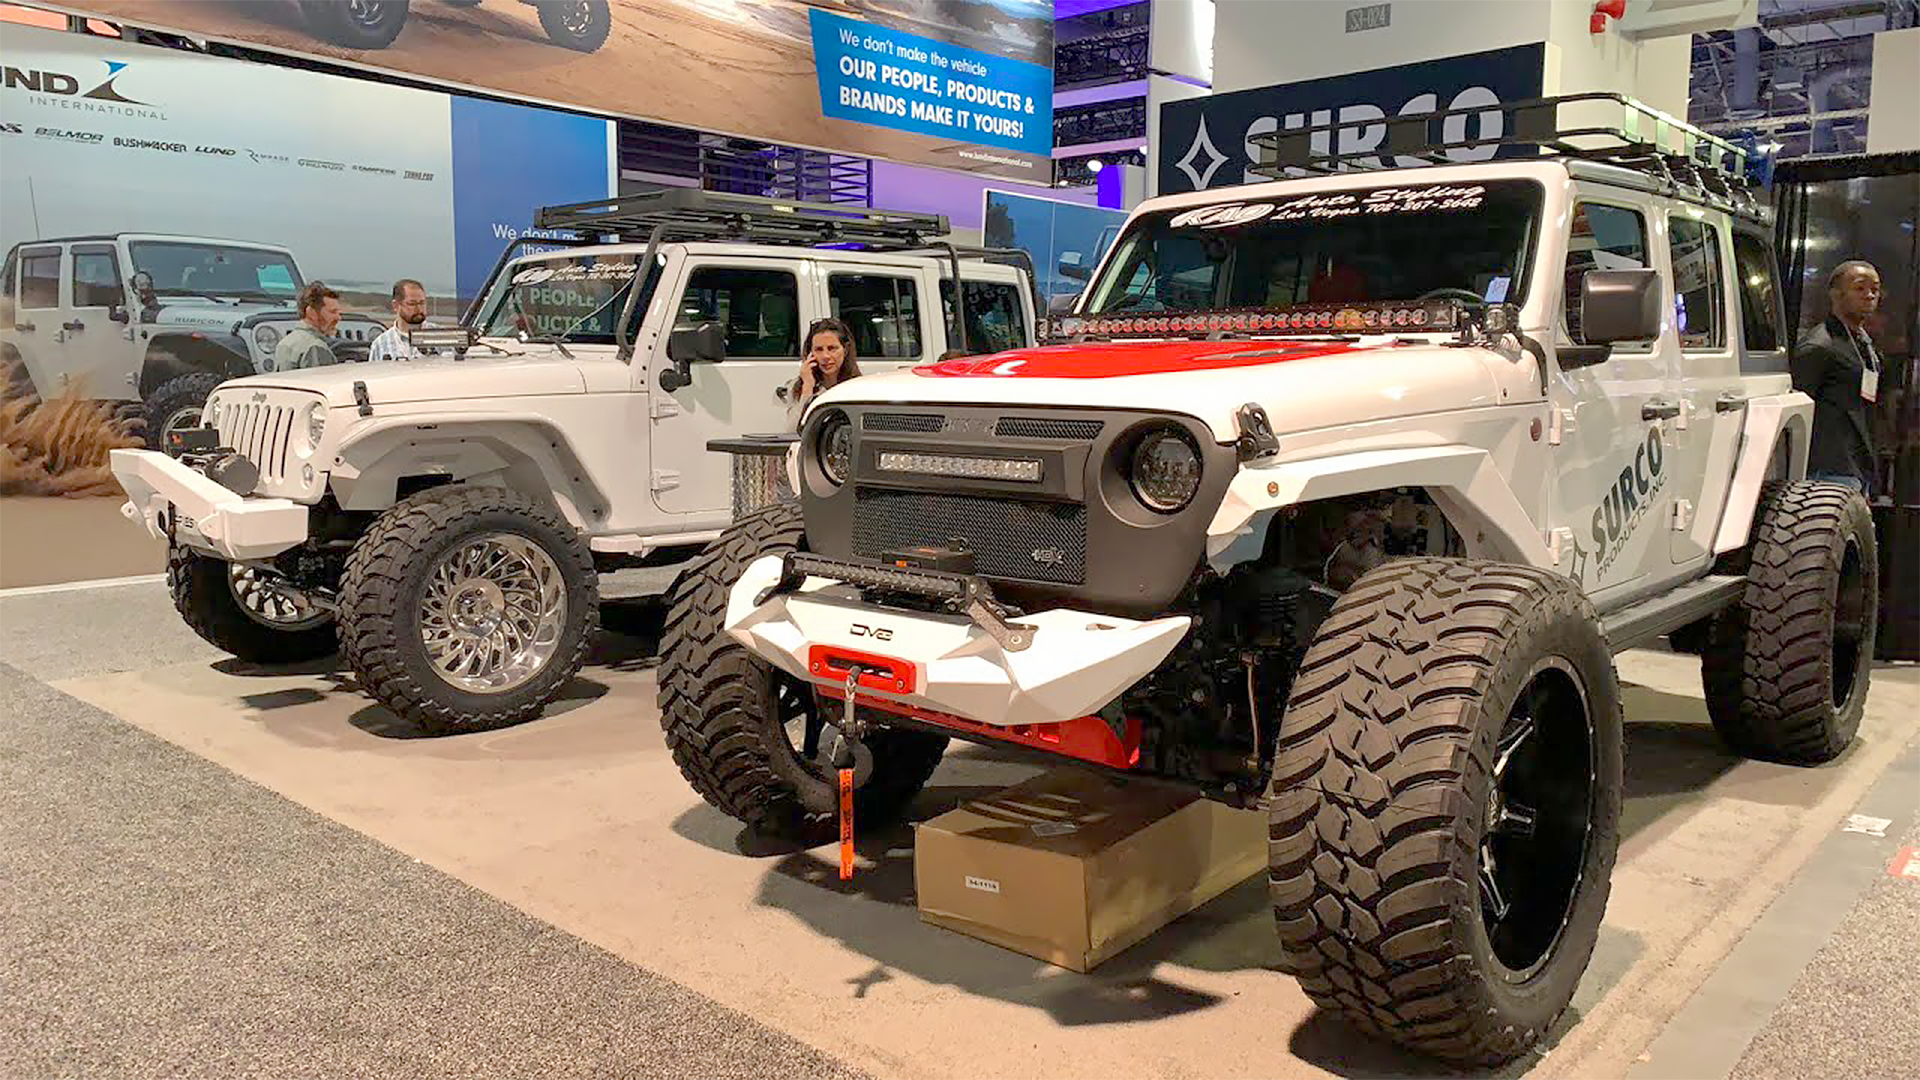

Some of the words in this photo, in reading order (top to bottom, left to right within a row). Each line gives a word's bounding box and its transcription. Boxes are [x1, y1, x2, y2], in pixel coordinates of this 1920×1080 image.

[839, 28, 860, 47] We
[863, 36, 894, 55] don't
[896, 44, 928, 63] make
[930, 51, 949, 68] the
[951, 58, 987, 77] vehicle
[0, 66, 79, 95] ND
[839, 56, 877, 81] OUR
[881, 65, 942, 98] PEOPLE,
[947, 79, 1021, 112] PRODUCTS
[1024, 97, 1035, 115] &
[30, 96, 168, 121] INTERNATIONAL
[839, 86, 907, 117] BRANDS
[911, 101, 953, 126] MAKE
[957, 110, 970, 129] IT
[974, 113, 1024, 139] YOURS!
[34, 127, 104, 141] BELMOR
[113, 137, 187, 153] BUSHWACKER
[195, 146, 236, 156] LUND
[1276, 195, 1355, 211] Auto
[1361, 185, 1486, 204] Styling
[1270, 210, 1306, 220] Las
[1309, 207, 1360, 219] Vegas
[492, 223, 517, 239] We
[175, 317, 225, 325] RUBICON
[1592, 425, 1662, 565] SURCO
[1596, 500, 1647, 583] PRODUCTS
[1650, 471, 1668, 501] INC.
